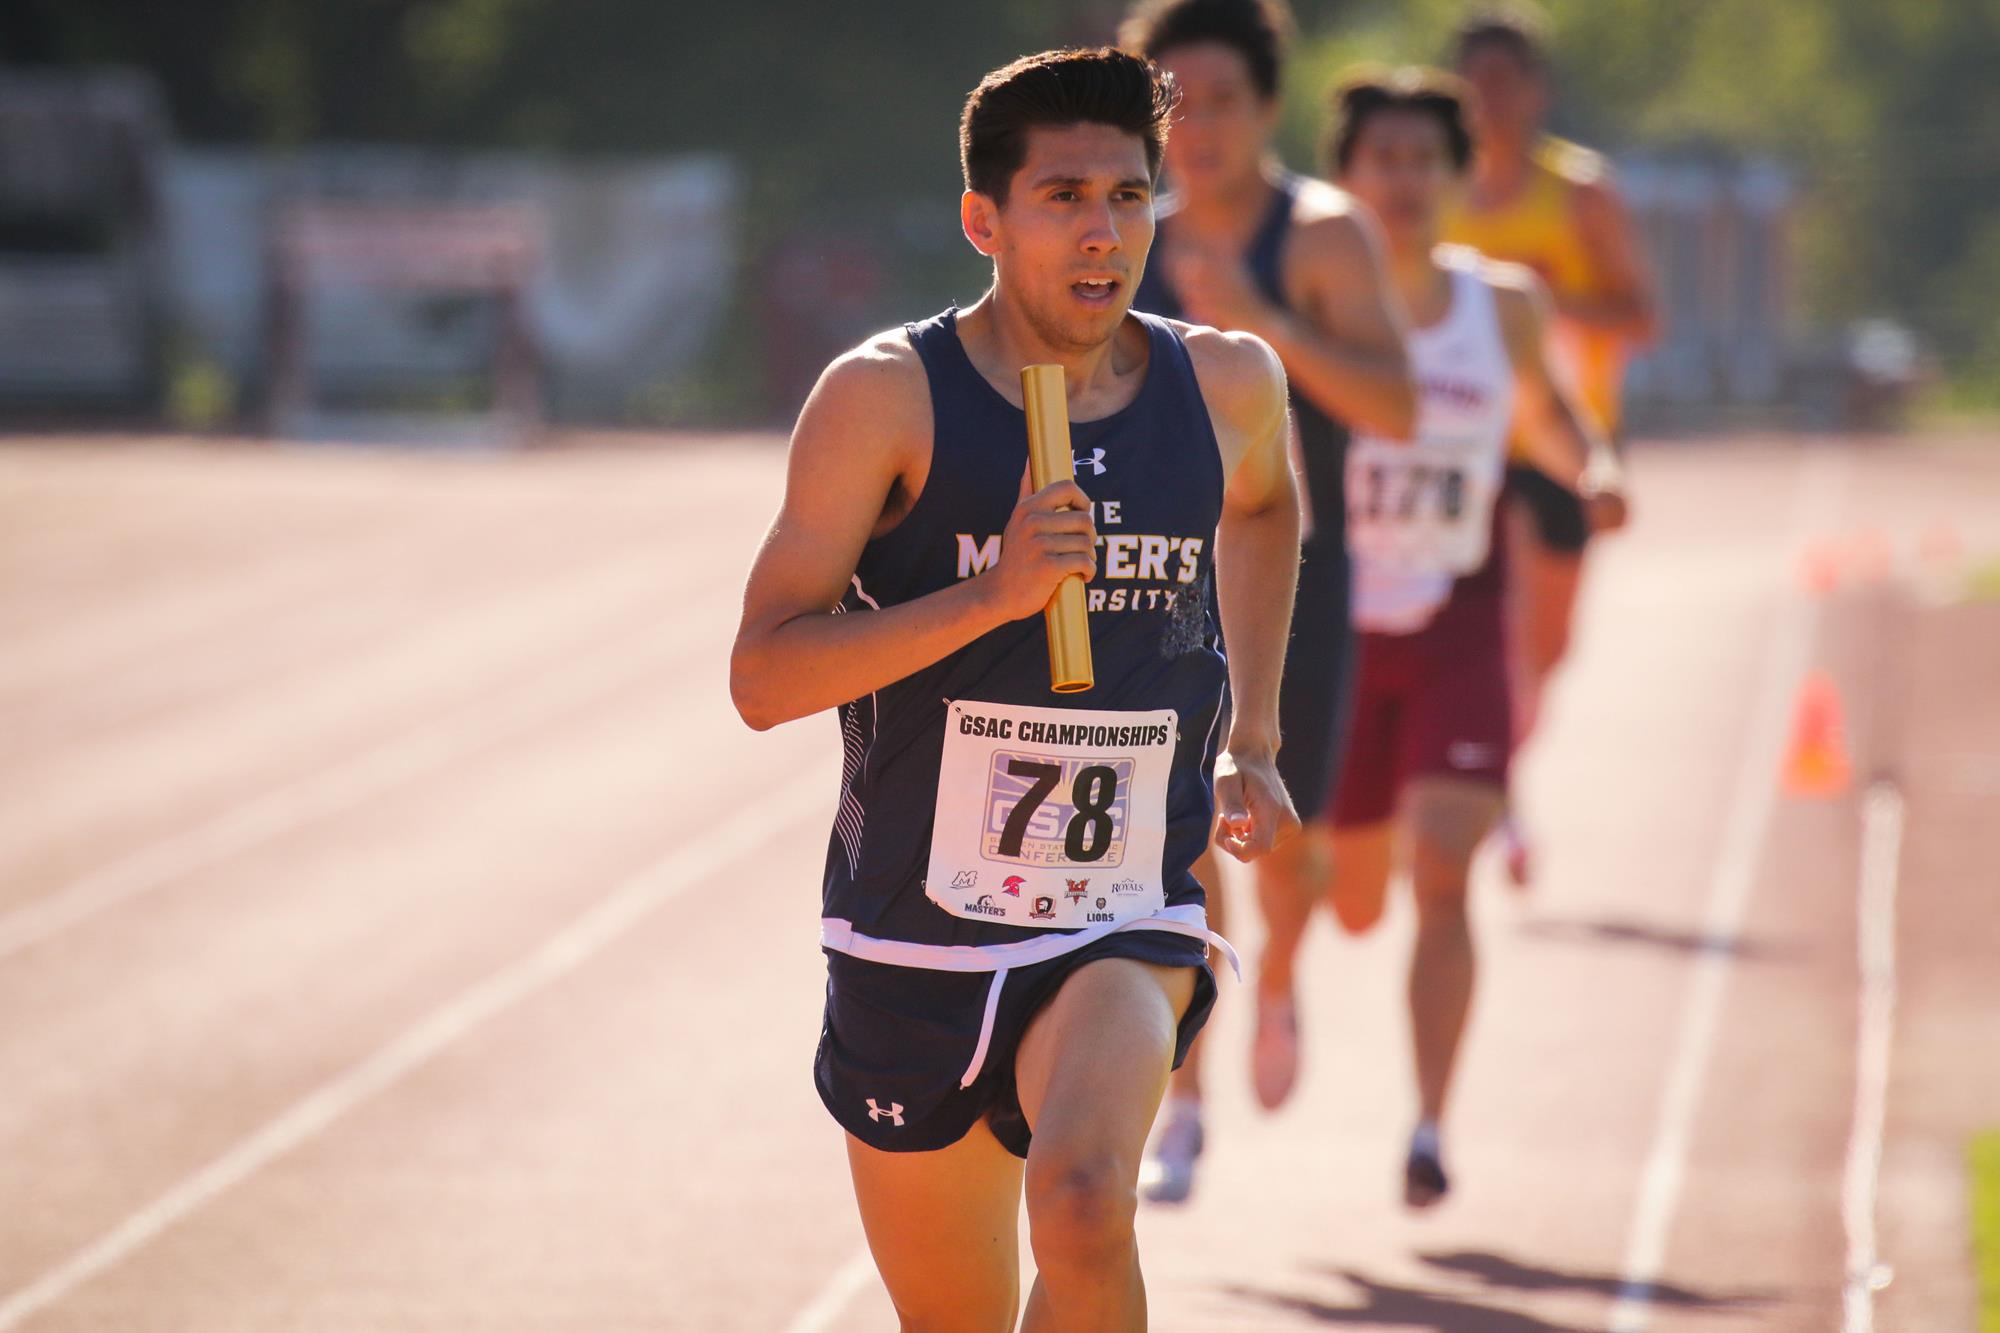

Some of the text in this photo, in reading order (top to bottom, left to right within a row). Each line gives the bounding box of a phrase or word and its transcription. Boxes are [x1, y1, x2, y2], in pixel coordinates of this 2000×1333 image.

[956, 533, 1204, 585] MER'S
[1088, 588, 1177, 612] RSITY
[960, 715, 1168, 747] GSAC CHAMPIONSHIPS
[998, 759, 1118, 862] 78
[964, 903, 1006, 917] MASTER'S
